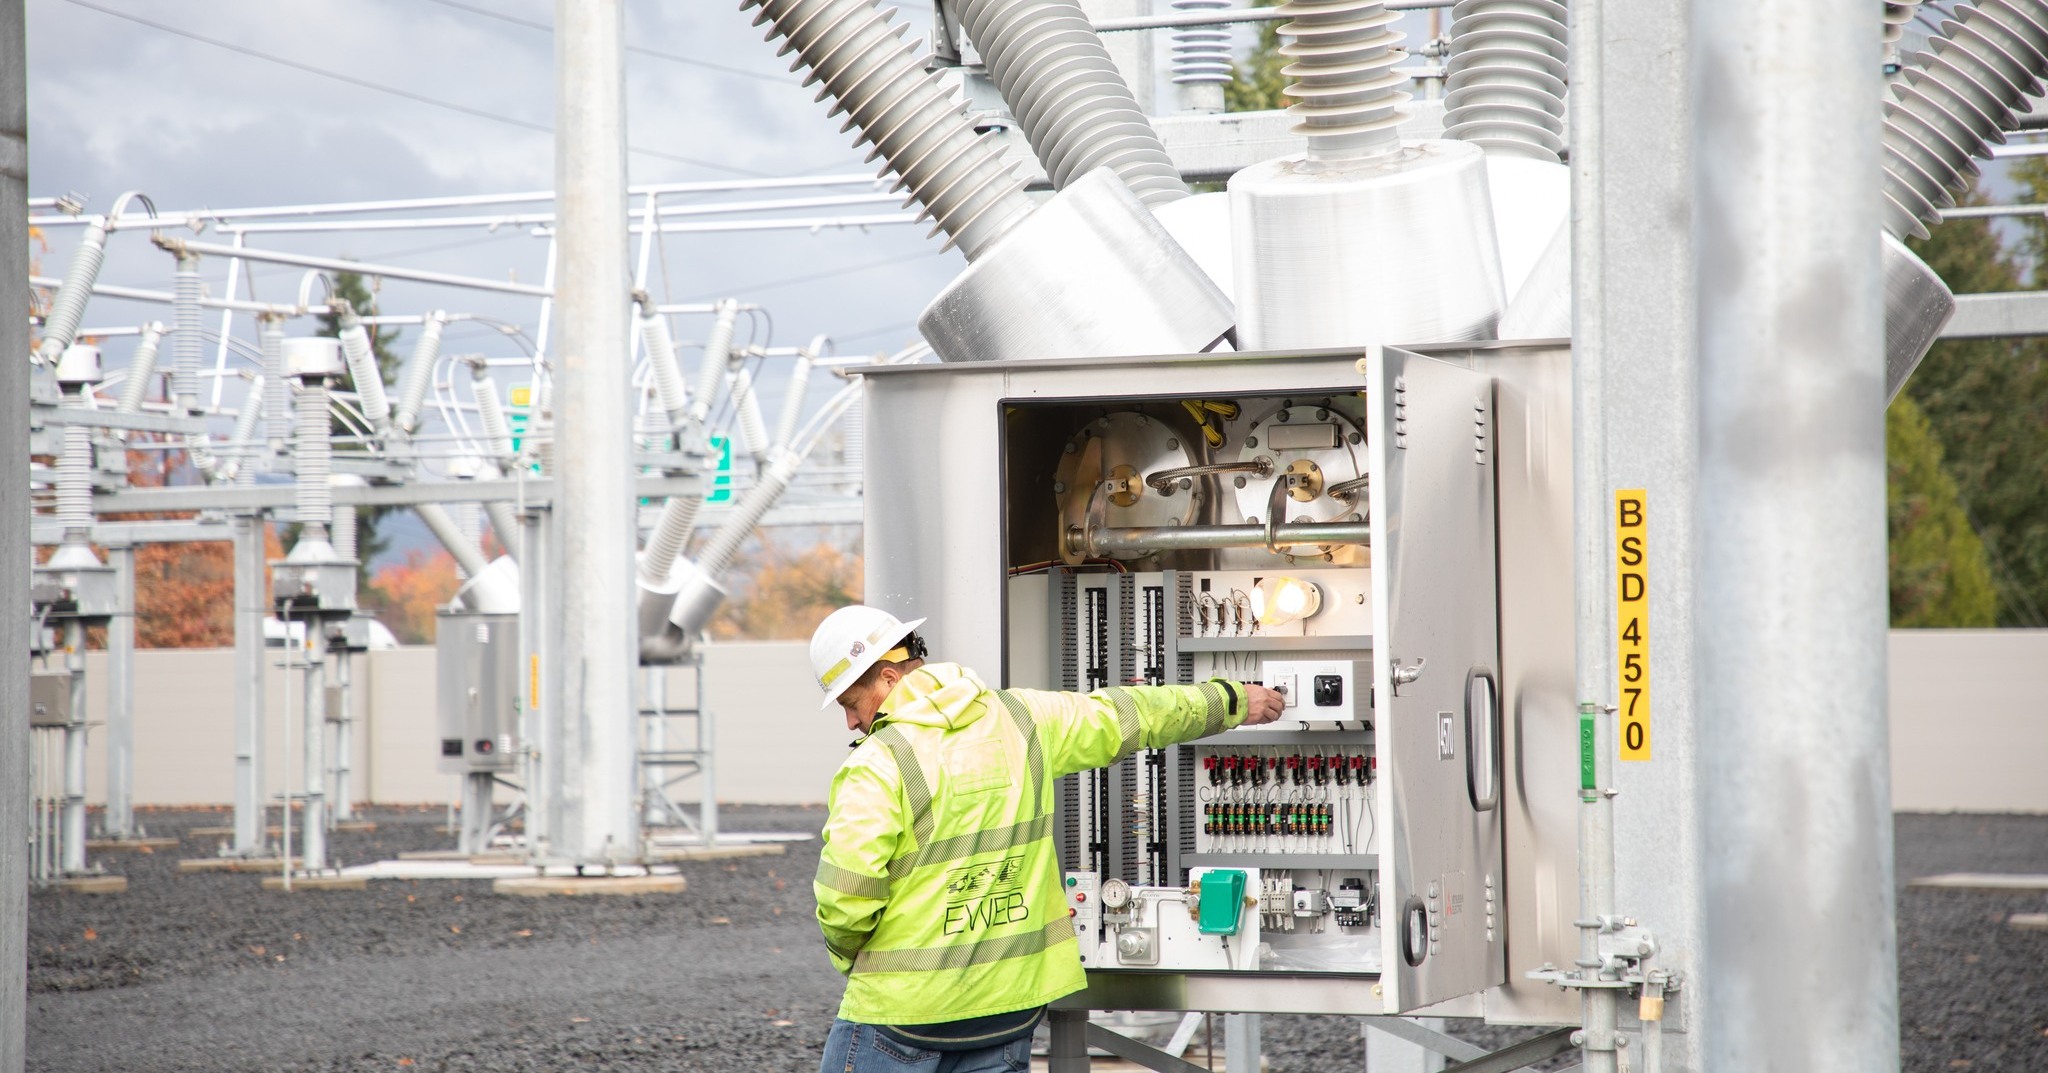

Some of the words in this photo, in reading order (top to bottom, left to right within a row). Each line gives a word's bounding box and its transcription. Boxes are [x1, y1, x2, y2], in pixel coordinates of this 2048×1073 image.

[1620, 499, 1644, 602] BSD
[1622, 617, 1645, 751] 4570
[1440, 717, 1454, 755] 4570
[1583, 729, 1592, 776] OPEN
[944, 892, 1029, 936] EWEB
